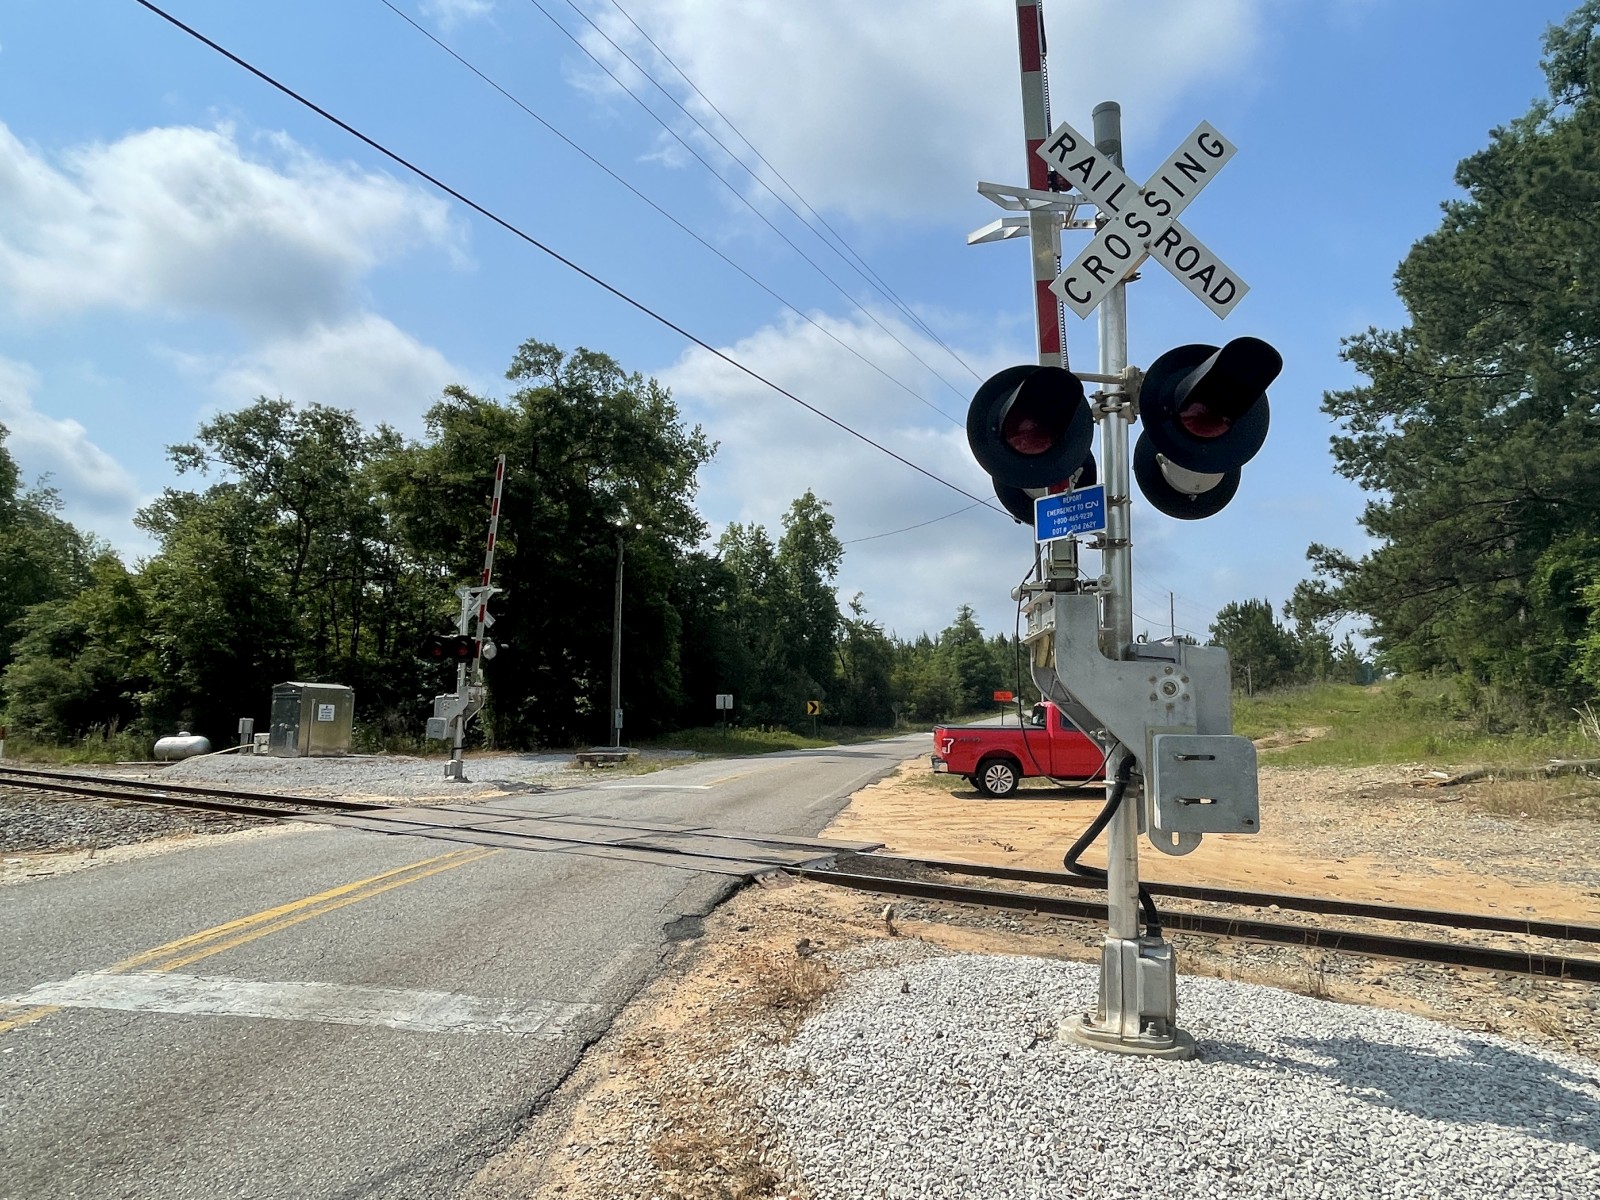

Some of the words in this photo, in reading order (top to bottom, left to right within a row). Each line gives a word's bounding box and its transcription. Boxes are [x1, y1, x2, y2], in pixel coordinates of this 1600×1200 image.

[1047, 132, 1126, 212] RAIL
[1153, 226, 1236, 305] ROAD
[1064, 132, 1225, 304] CROSSING
[1062, 494, 1082, 503] REPORT
[1046, 505, 1076, 517] EMERGENCY
[1085, 500, 1099, 509] CN
[1052, 527, 1062, 535] DOT
